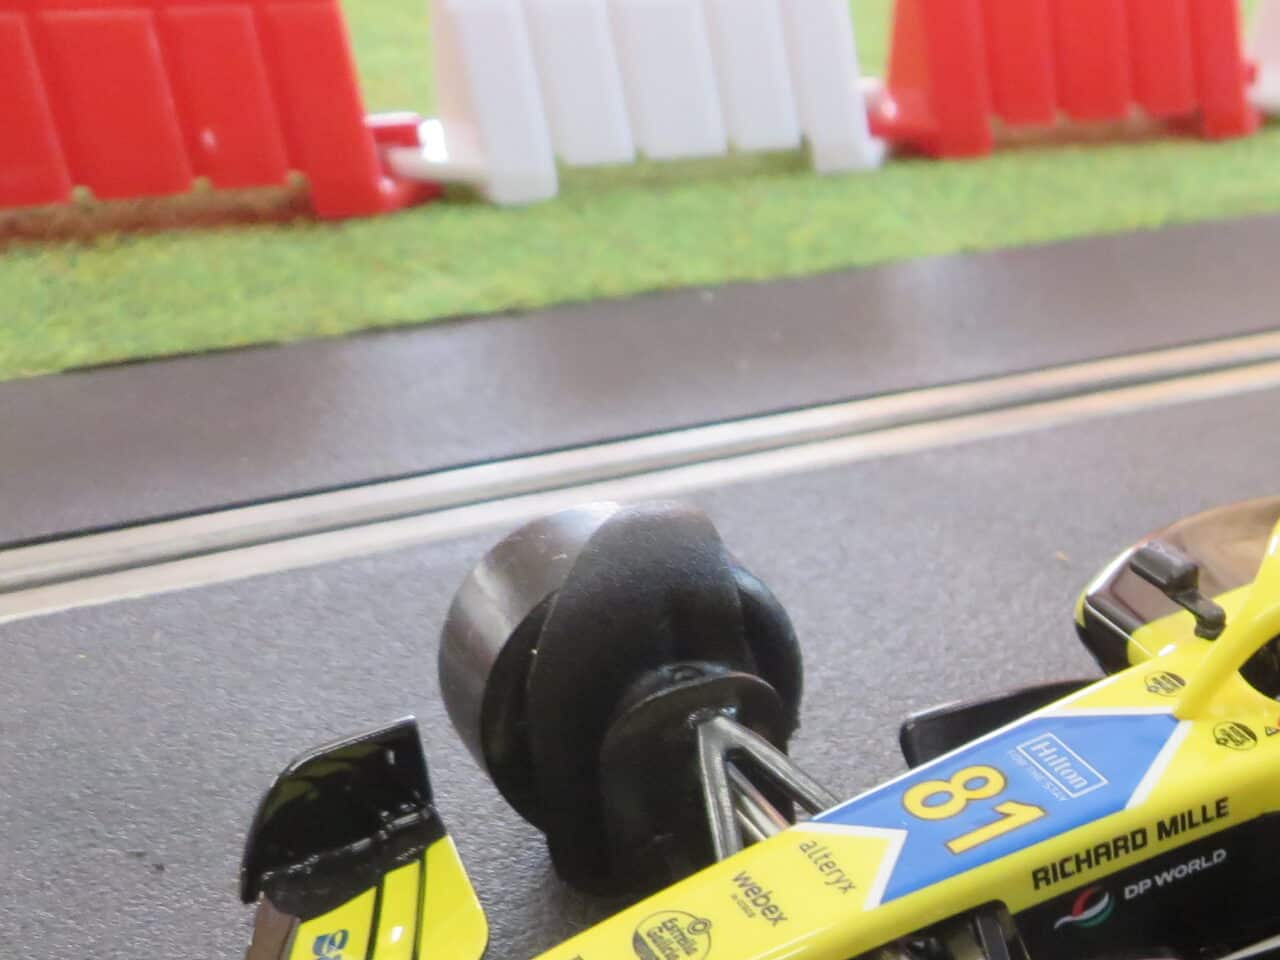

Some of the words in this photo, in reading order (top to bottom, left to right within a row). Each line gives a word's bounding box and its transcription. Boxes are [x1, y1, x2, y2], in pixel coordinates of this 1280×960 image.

[1031, 741, 1089, 790] Hilton
[903, 764, 1048, 856] 81
[799, 839, 859, 896] alteryx
[1031, 827, 1149, 891] RICHARD
[1156, 796, 1231, 841] MILLE
[732, 870, 790, 928] webex
[1123, 878, 1153, 901] DP
[1154, 848, 1228, 888] WORLD
